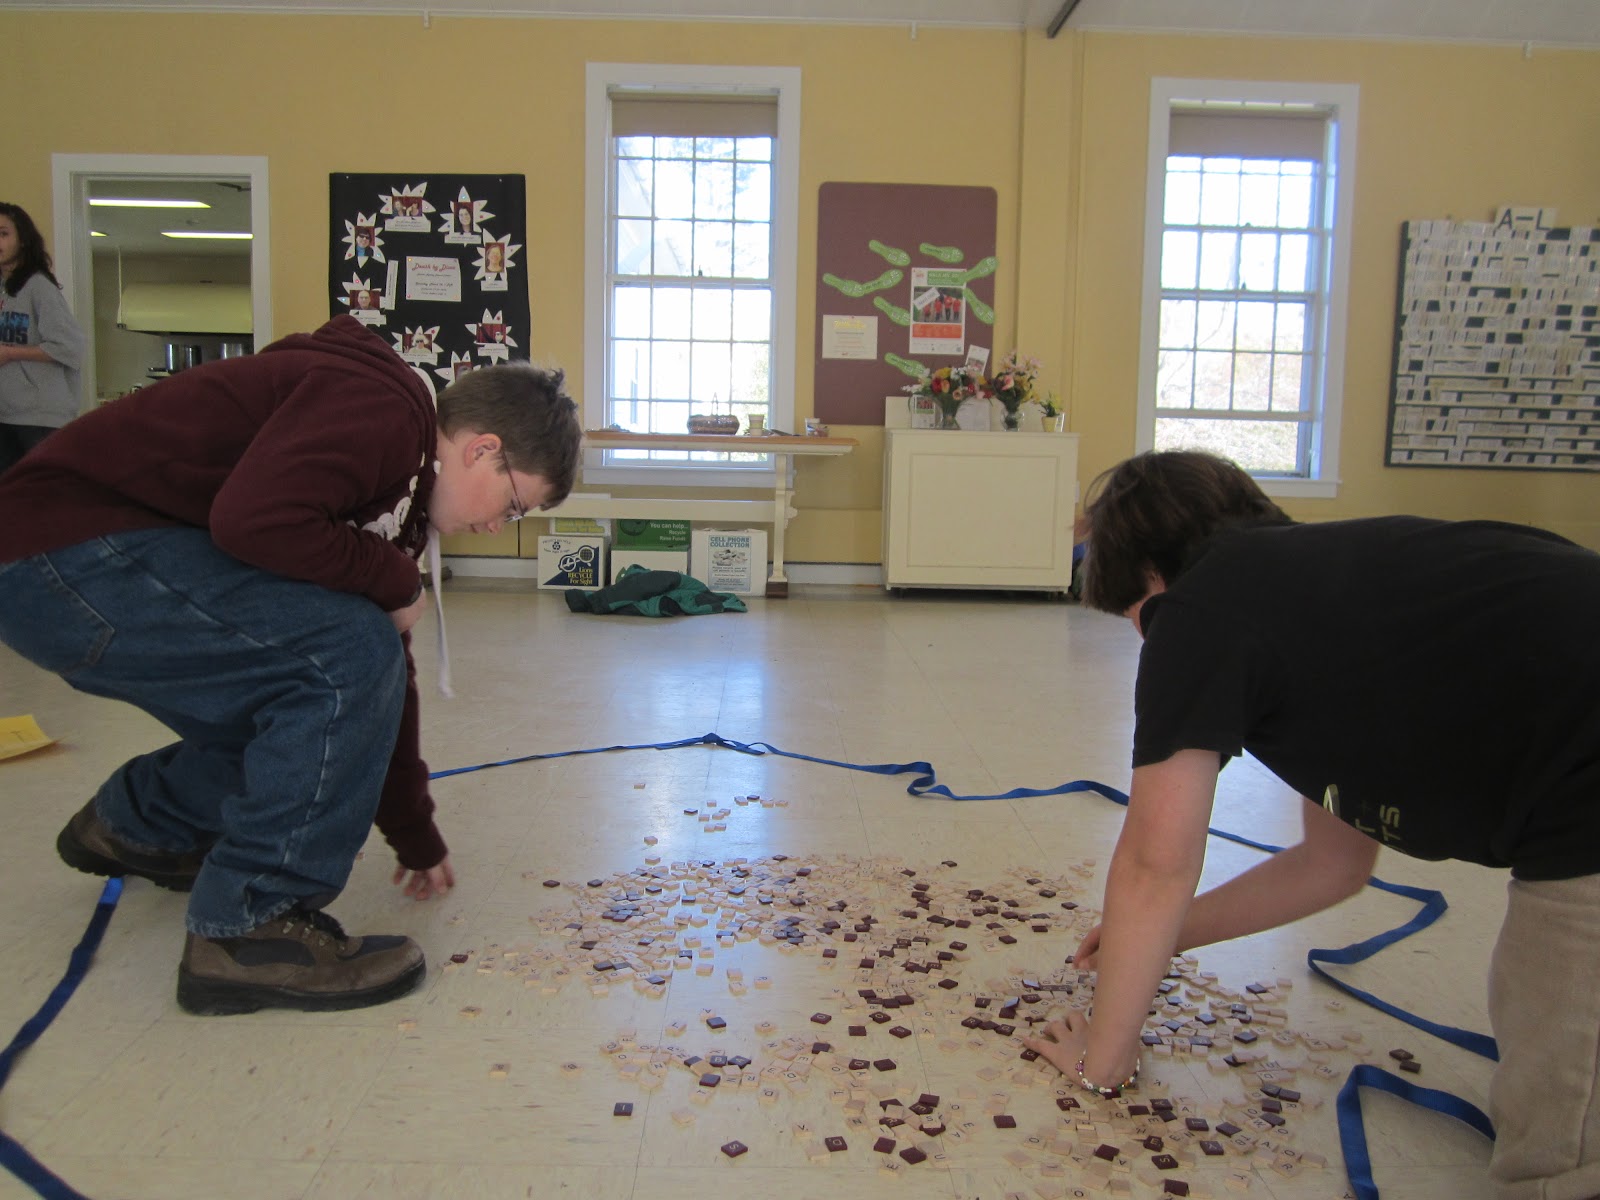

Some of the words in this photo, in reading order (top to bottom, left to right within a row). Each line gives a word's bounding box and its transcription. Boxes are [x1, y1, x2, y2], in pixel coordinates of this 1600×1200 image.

[412, 262, 431, 271] Death
[432, 263, 439, 272] by
[579, 578, 593, 586] Sight
